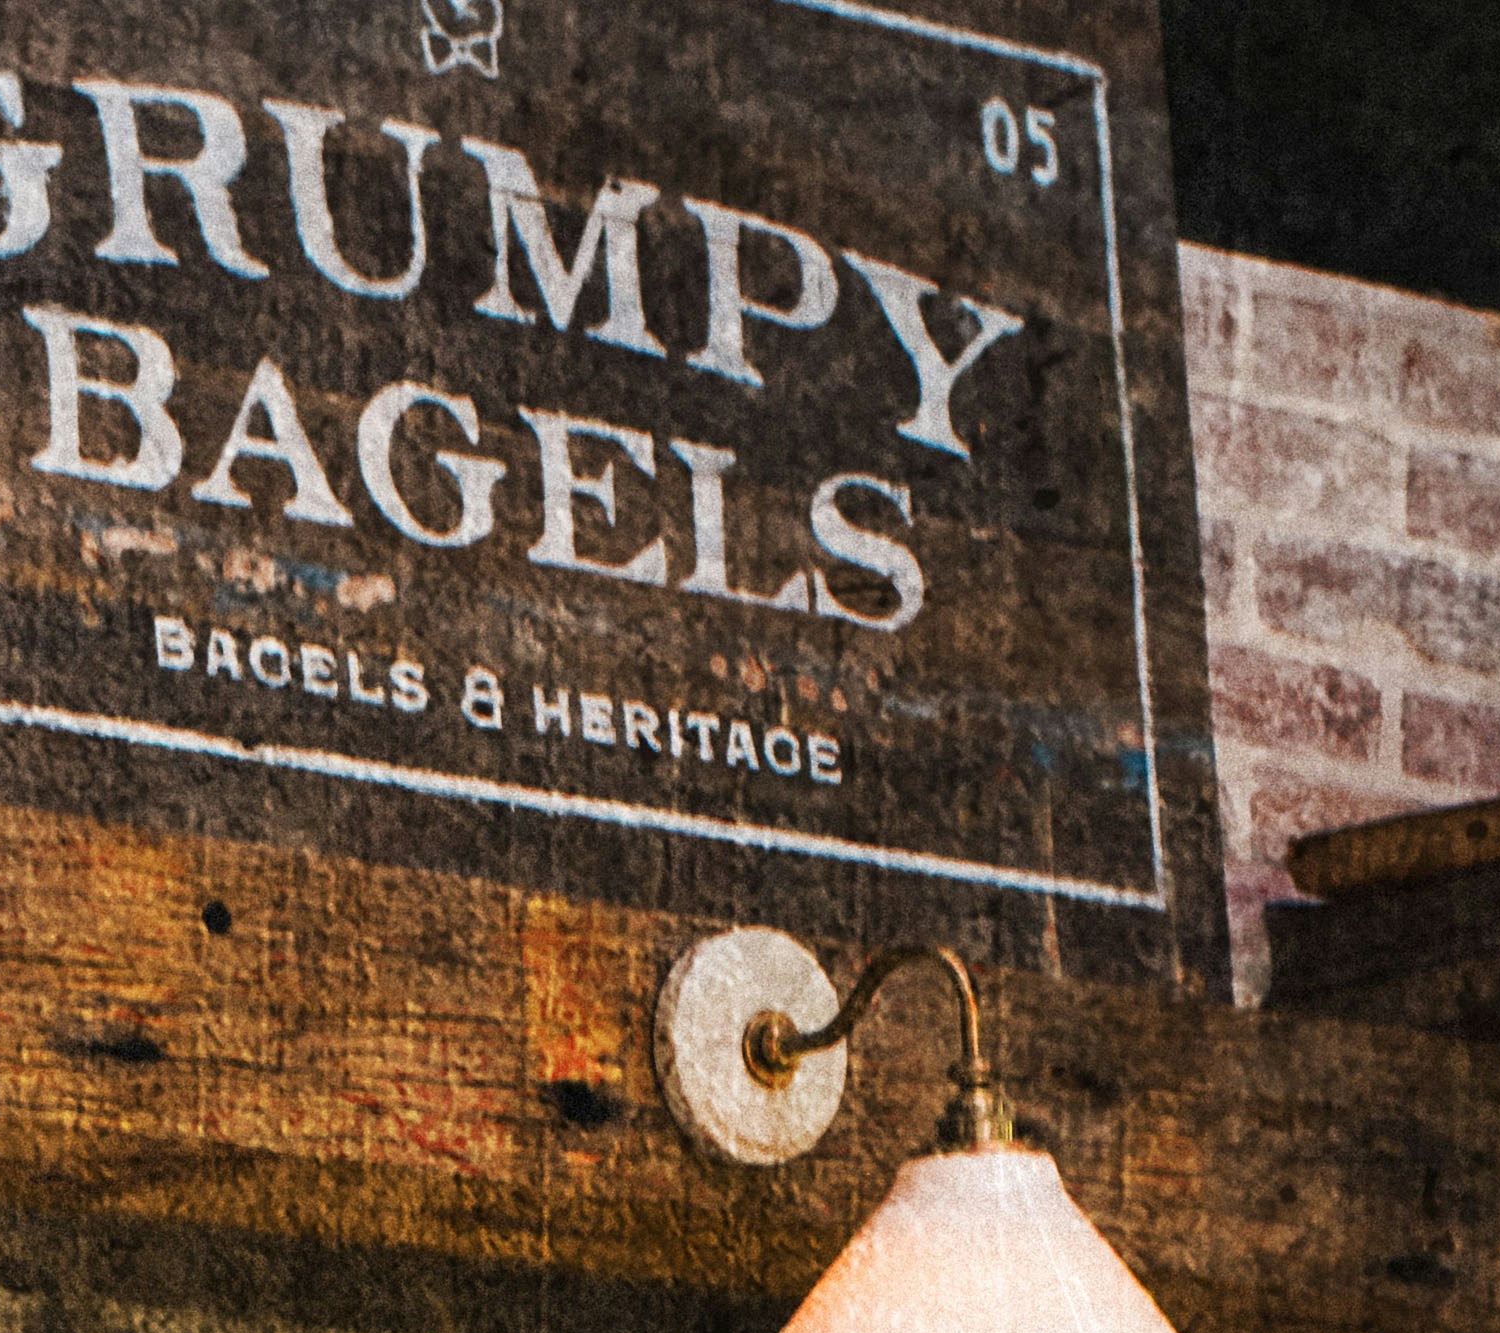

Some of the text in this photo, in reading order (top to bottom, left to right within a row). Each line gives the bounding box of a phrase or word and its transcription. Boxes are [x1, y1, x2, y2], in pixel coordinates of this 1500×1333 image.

[980, 98, 1059, 188] 05
[22, 304, 930, 633] BAGELS
[153, 615, 845, 787] BAGELS & HERITAGE
